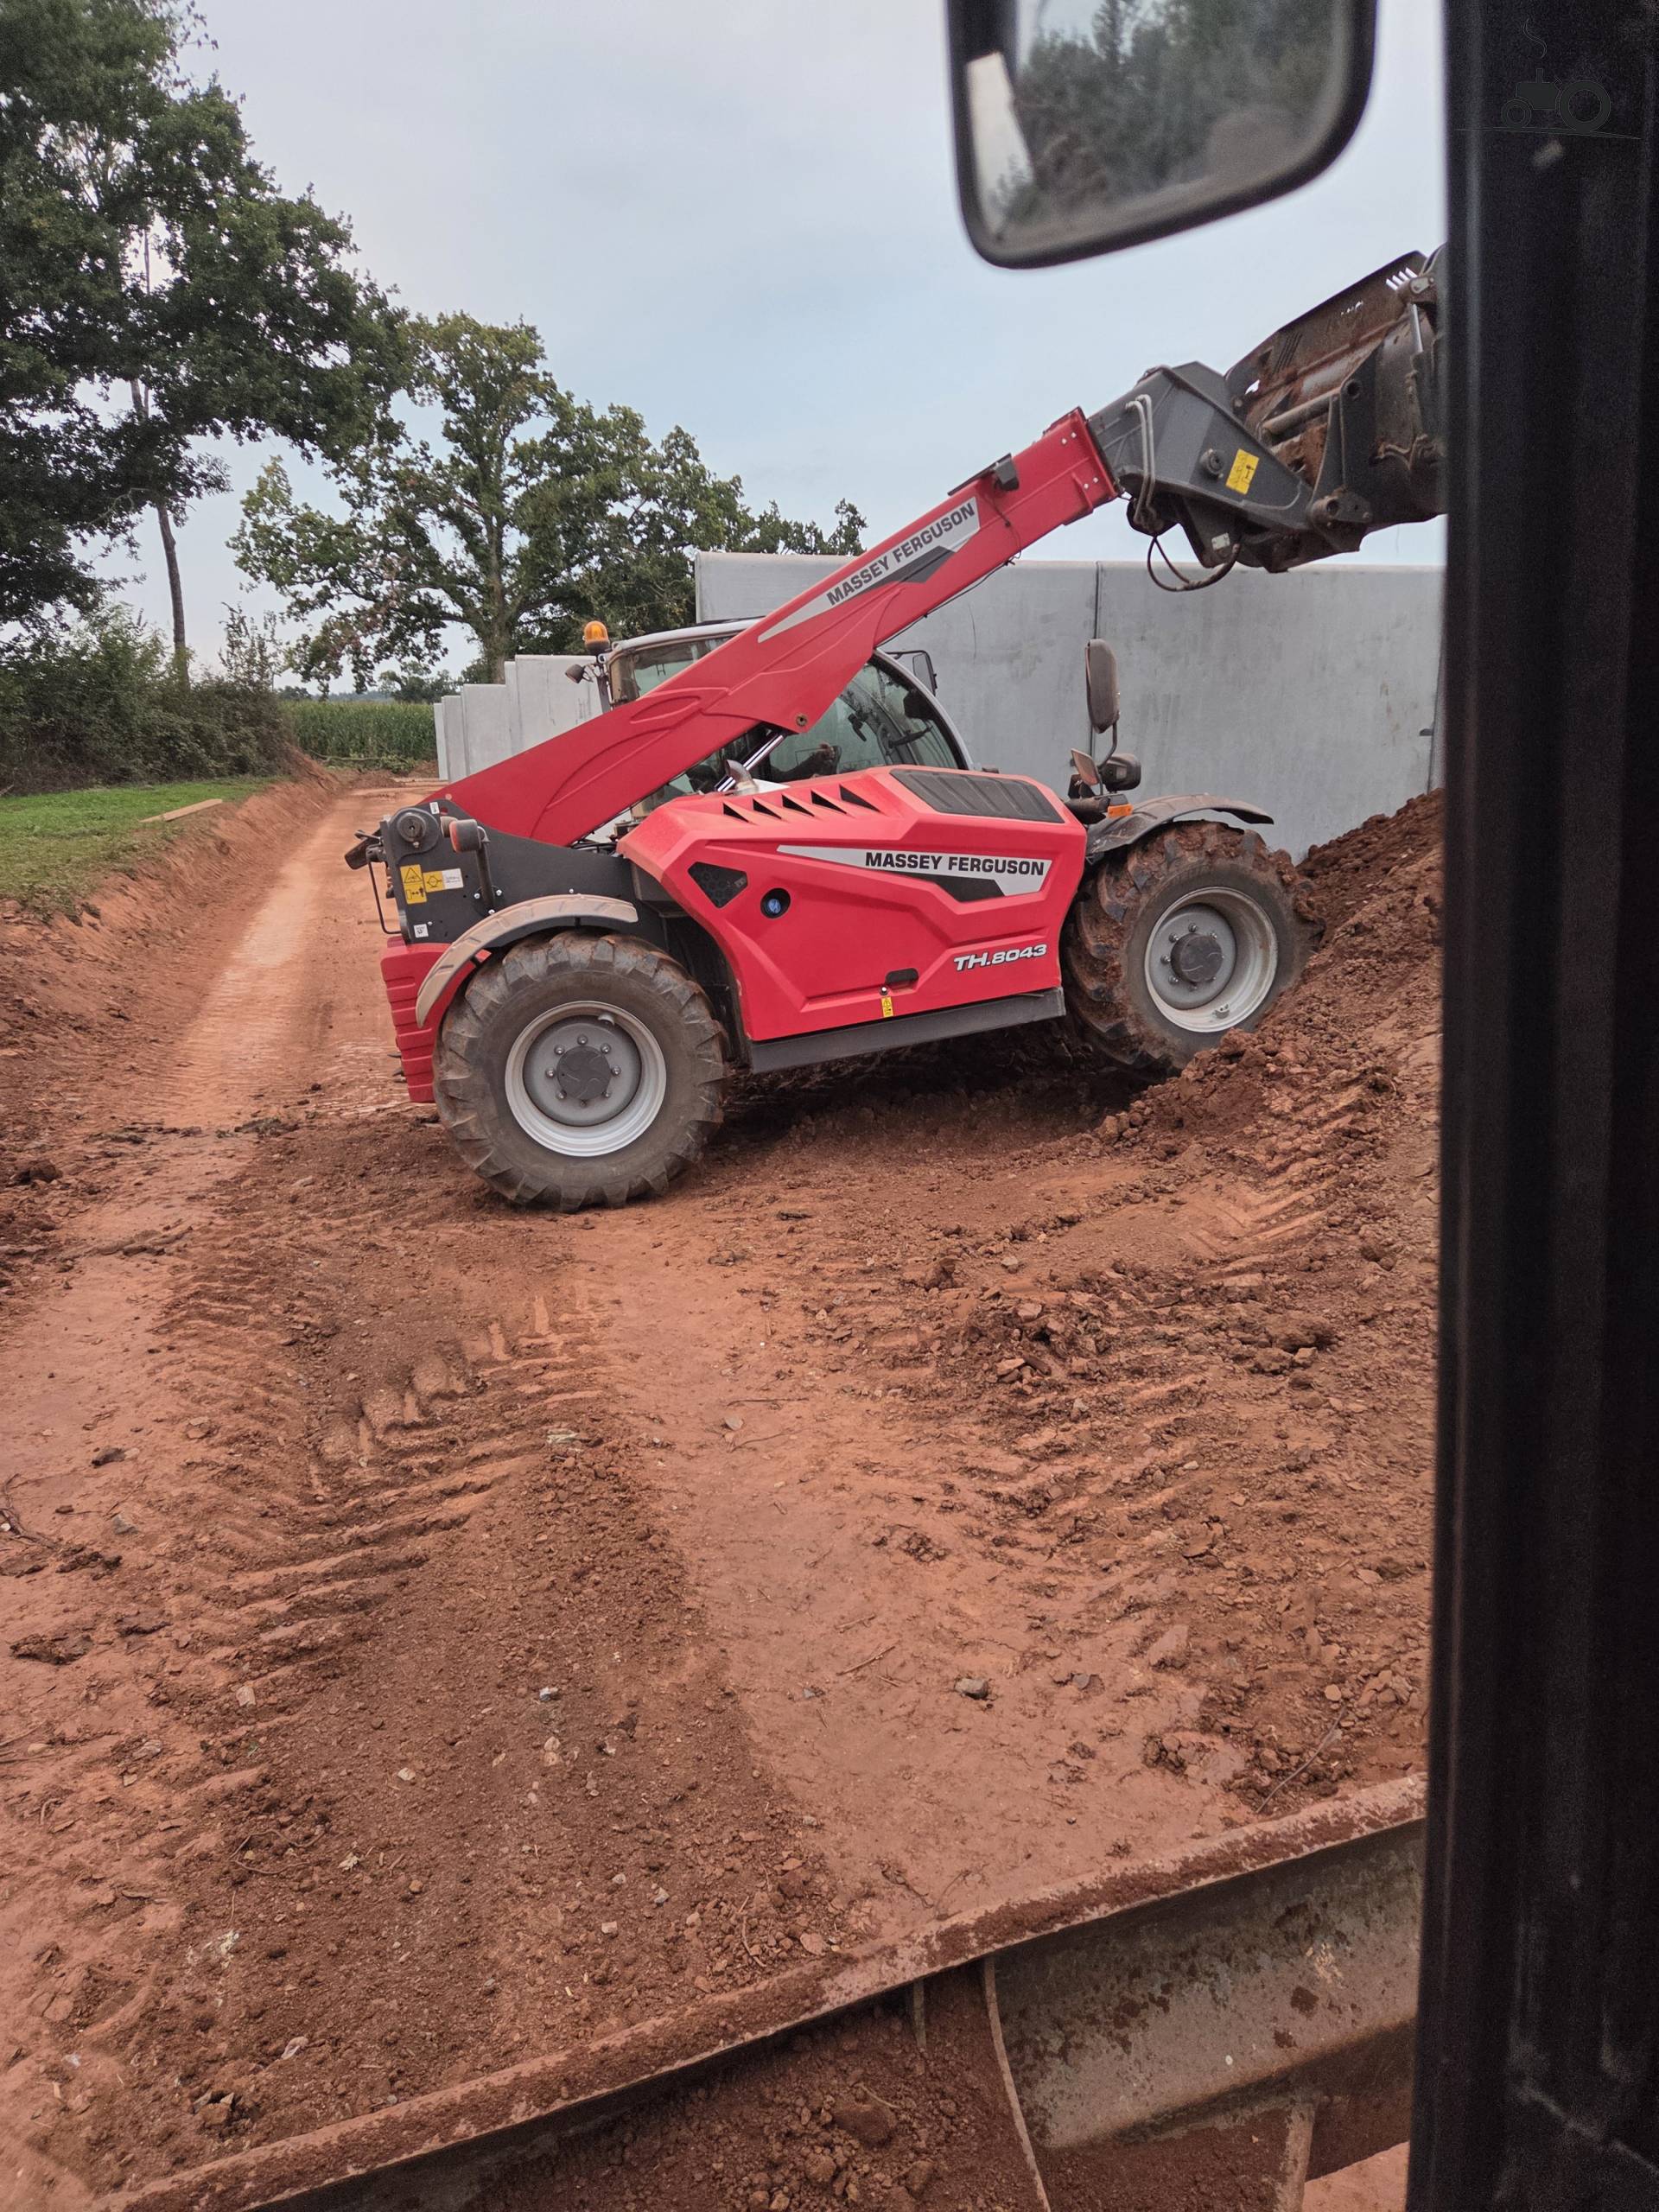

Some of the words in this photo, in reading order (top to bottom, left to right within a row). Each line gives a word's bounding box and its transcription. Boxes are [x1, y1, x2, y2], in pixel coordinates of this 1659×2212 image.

[826, 556, 890, 606] MASSEY
[892, 502, 976, 563] FERGUSON
[865, 852, 943, 870] MASSEY
[948, 856, 1045, 876] FERGUSON
[954, 944, 1047, 971] TH.8043
